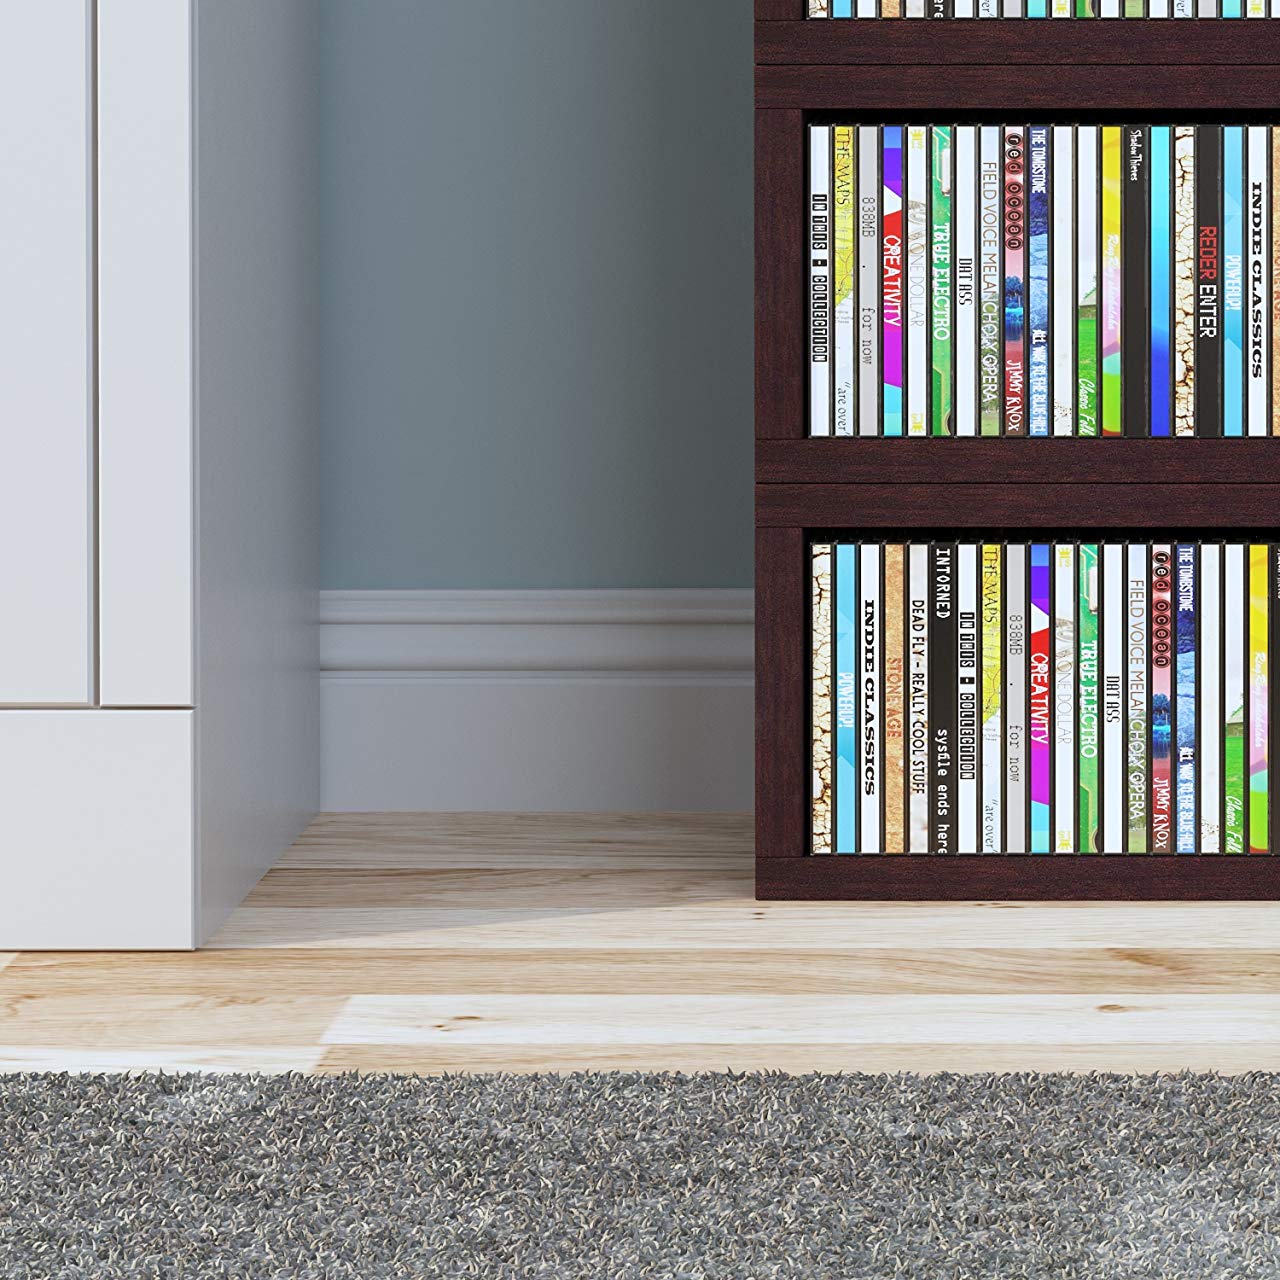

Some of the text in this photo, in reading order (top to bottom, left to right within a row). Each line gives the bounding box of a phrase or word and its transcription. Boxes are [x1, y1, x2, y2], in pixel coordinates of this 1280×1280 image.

[1032, 130, 1045, 193] THE TOMBSTONE
[862, 197, 874, 237] 838MB
[1006, 181, 1023, 250] ocean
[812, 194, 827, 362] IN THIS COLLECTION
[934, 223, 949, 340] TRUE ELECTRO
[983, 162, 997, 402] FIELD VOICE MELANCHOLY OPERA
[1199, 226, 1216, 338] REDER ENTER
[1252, 182, 1262, 378] INDIE CLASSICS
[862, 308, 875, 364] for now
[1006, 360, 1022, 431] JIMMY KNOX
[1079, 378, 1095, 435] Classic Folk
[937, 549, 951, 619] INTORNED
[985, 549, 998, 623] THE MAPS
[1179, 548, 1192, 611] THE TOMBSTONE
[887, 658, 902, 738] STONE AGE
[1031, 653, 1048, 744] CREATIVITY
[1081, 641, 1097, 758] TRUE ELECTRO
[1131, 580, 1145, 819] FIELD VOICE MELANCHOLY OPERA
[936, 729, 950, 776] sysfile
[938, 785, 950, 815] ends
